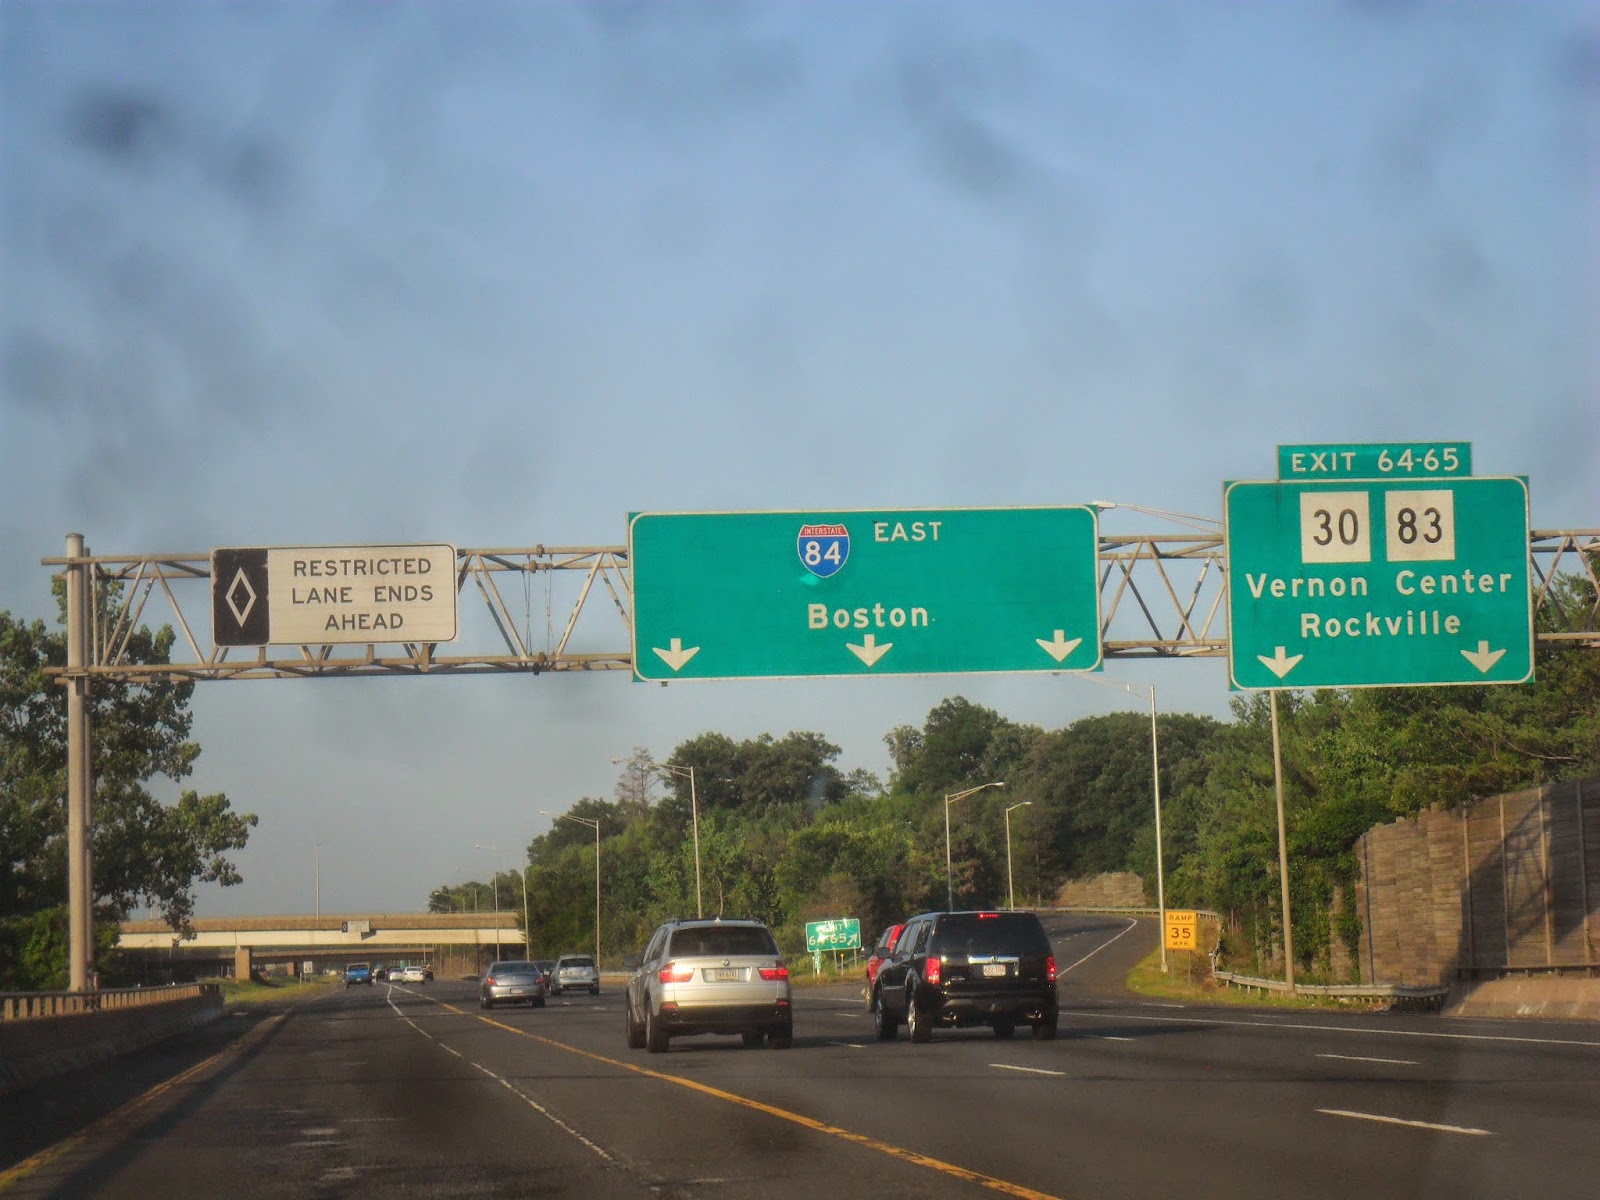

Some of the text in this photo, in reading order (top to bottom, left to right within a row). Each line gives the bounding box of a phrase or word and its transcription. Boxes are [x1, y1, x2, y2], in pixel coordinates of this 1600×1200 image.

[1291, 447, 1459, 472] EXIT 64-65
[804, 526, 843, 535] INTERSTATE
[874, 521, 942, 542] EAST
[1312, 508, 1359, 546] 30
[1397, 506, 1442, 545] 83
[804, 540, 841, 566] 84
[293, 558, 432, 577] RESTRICTED
[292, 585, 434, 604] LANE ENDS
[1245, 568, 1512, 599] Vernon Center
[324, 613, 404, 631] AHEAD
[808, 602, 929, 630] Boston
[1300, 610, 1461, 638] Rockville
[1170, 927, 1191, 939] 35
